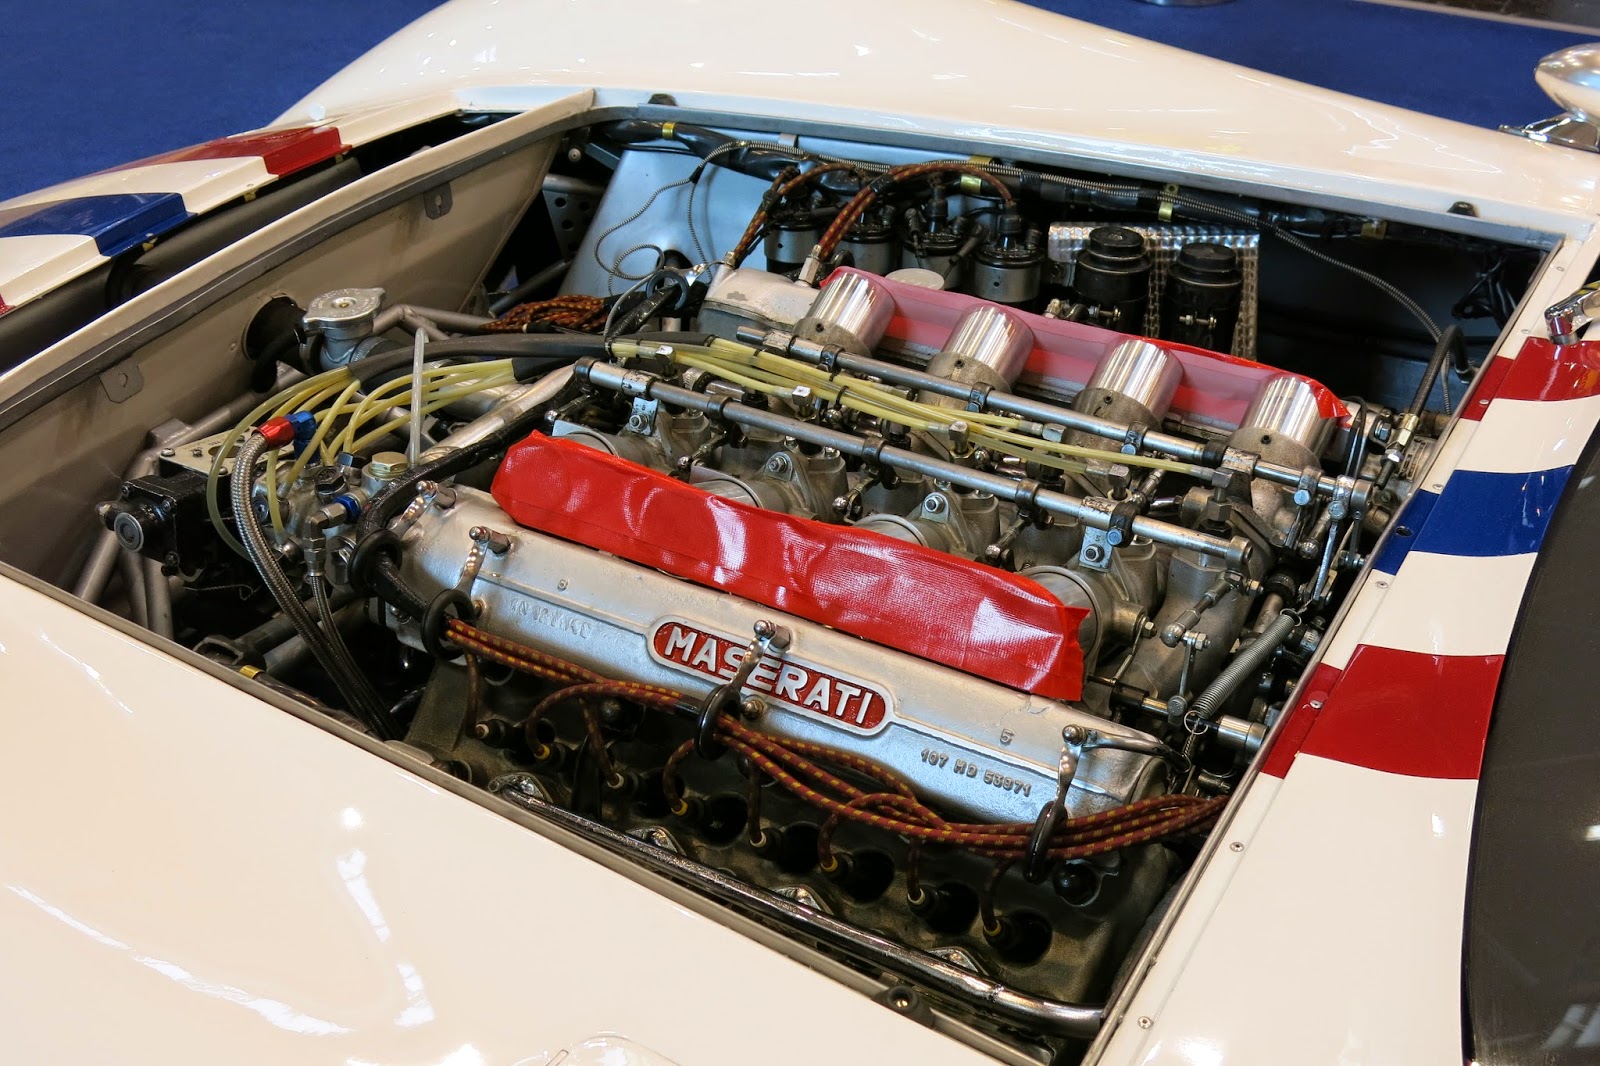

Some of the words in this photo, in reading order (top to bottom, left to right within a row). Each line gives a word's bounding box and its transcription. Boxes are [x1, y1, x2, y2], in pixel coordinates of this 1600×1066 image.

[664, 626, 873, 724] MASERATI
[1000, 728, 1014, 745] 5
[920, 748, 949, 767] 107
[983, 768, 1032, 797] 53971
